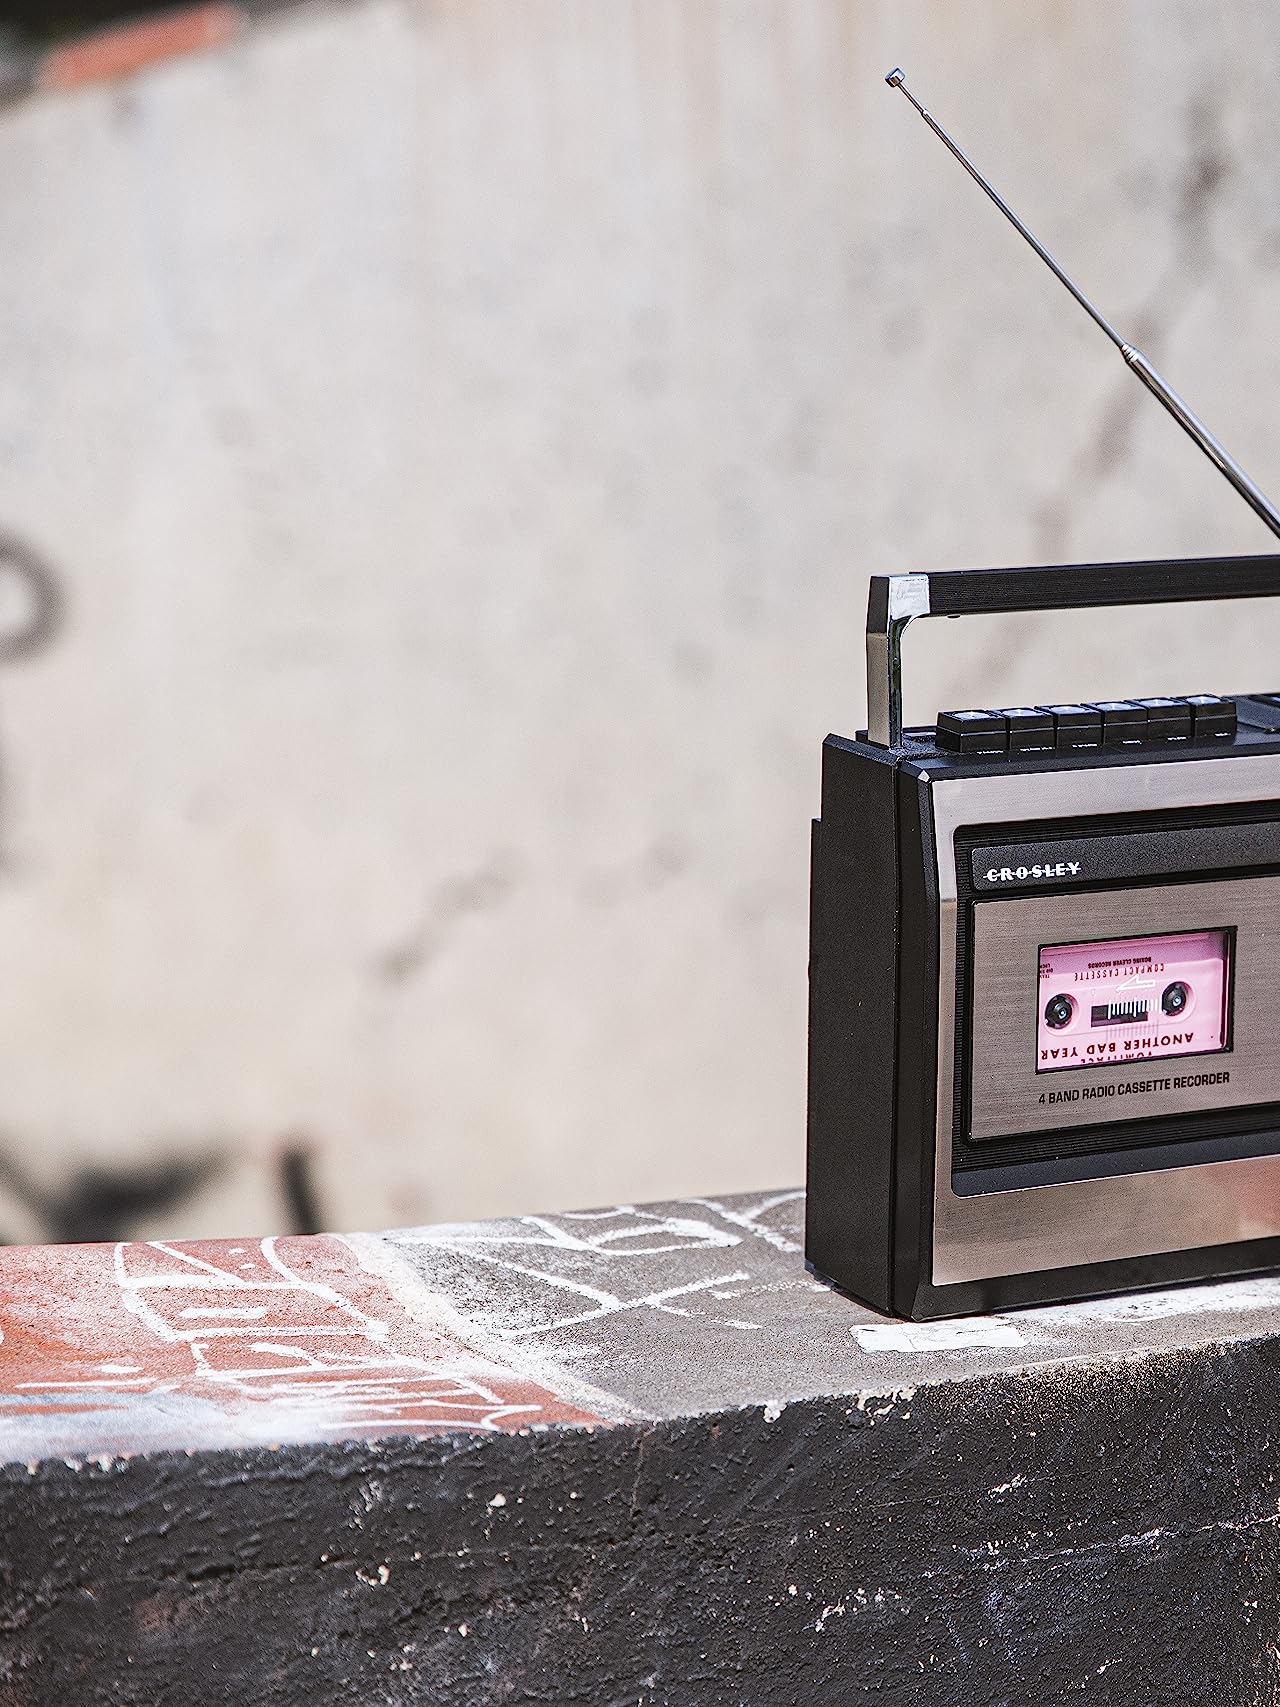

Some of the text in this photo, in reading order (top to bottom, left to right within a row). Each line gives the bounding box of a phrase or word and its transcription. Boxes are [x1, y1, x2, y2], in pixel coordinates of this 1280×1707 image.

[984, 861, 1081, 882] CROSLEY
[1088, 960, 1112, 969] RECORDS
[1112, 958, 1132, 967] CLEVER
[1074, 963, 1165, 982] COMPACT CASSETTE
[1086, 1042, 1116, 1055] BAD
[1124, 1032, 1194, 1051] ANOTHER
[1041, 1046, 1079, 1060] YEAR
[1038, 1072, 1230, 1105] 4 BAND RADIO CASSETTE RECORDER
